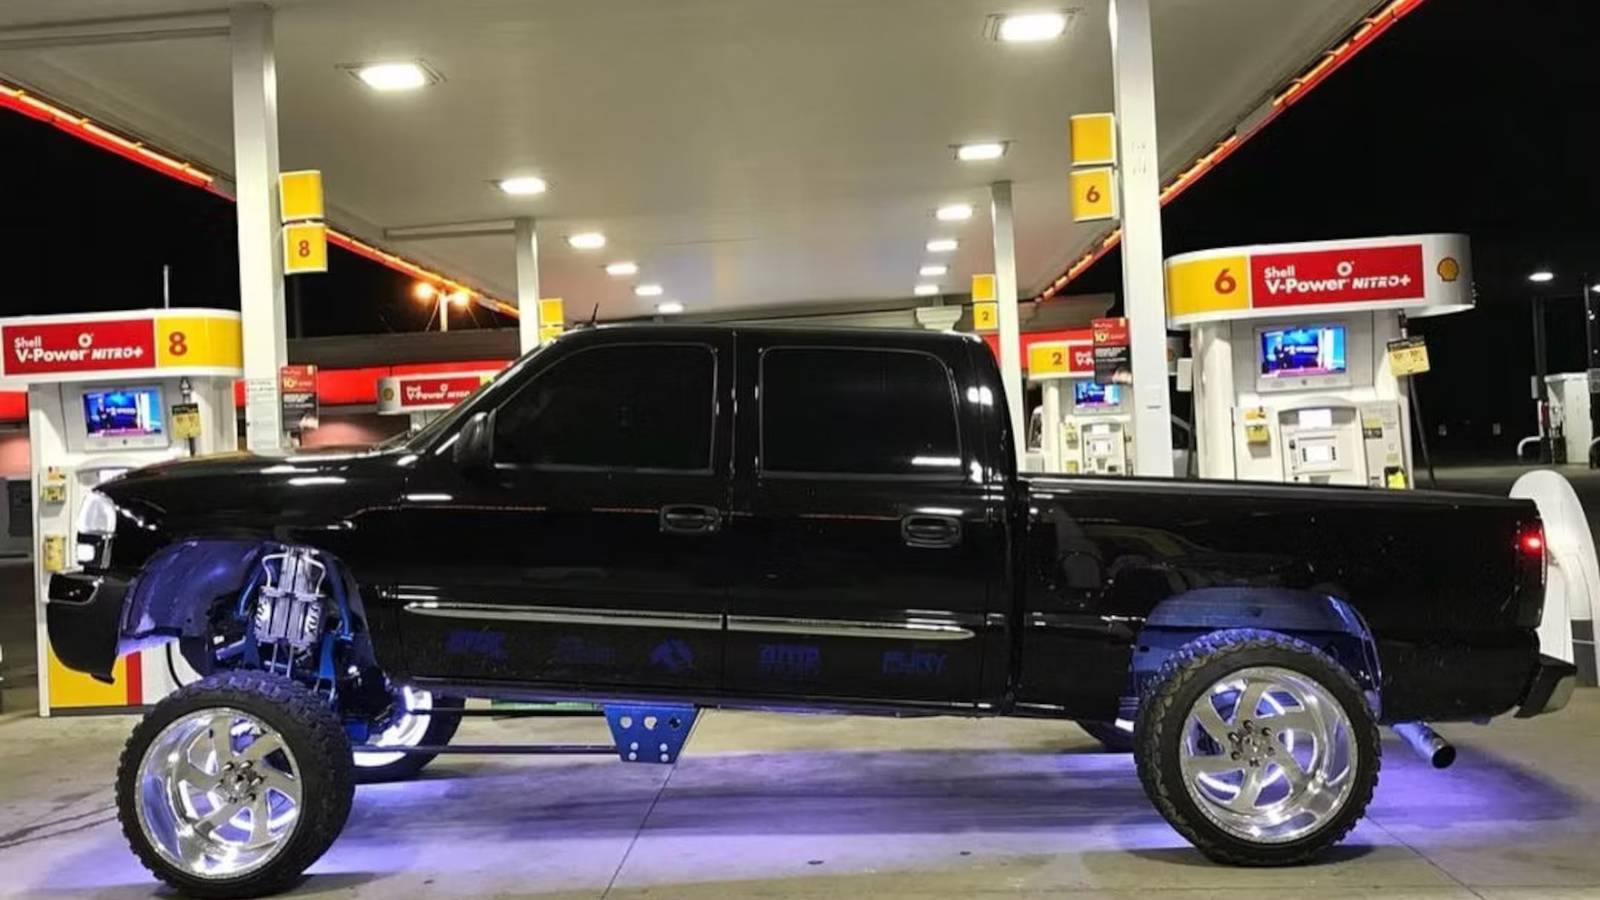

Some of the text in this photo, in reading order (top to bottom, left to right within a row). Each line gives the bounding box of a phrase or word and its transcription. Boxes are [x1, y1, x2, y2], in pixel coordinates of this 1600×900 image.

[1086, 185, 1100, 203] 6
[299, 240, 310, 257] 8
[1264, 264, 1296, 279] Shell
[1215, 268, 1236, 294] 6
[1264, 274, 1412, 296] V-Power NITRO+
[981, 311, 990, 321] 2
[14, 336, 42, 349] Shell
[169, 331, 188, 356] 8
[16, 347, 143, 363] V-Power NITRO+
[1052, 352, 1062, 366] 2
